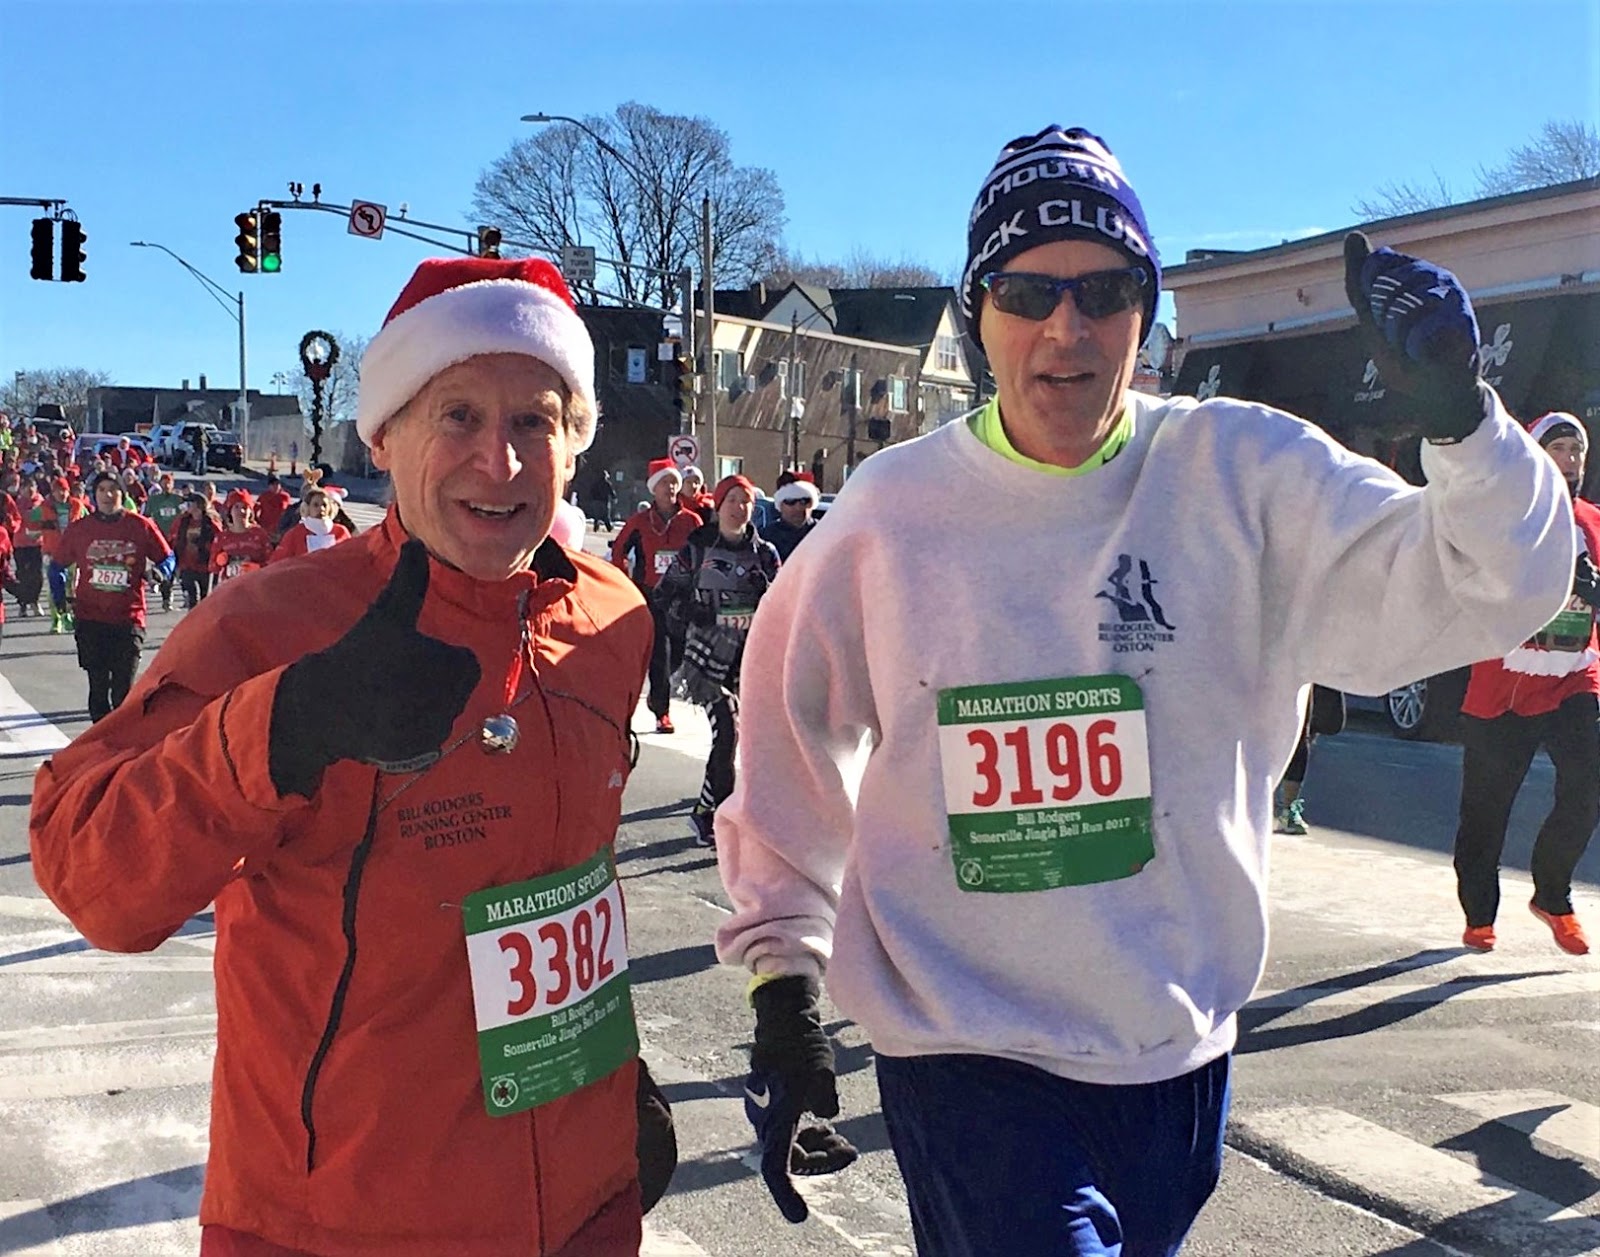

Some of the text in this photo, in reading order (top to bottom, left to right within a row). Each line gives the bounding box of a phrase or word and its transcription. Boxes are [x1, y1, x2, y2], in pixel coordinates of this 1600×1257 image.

[1038, 199, 1149, 257] CLUB
[97, 570, 124, 585] 2672
[1113, 642, 1154, 652] OSTON
[957, 687, 1122, 718] MARATHON SPORTS
[966, 719, 1123, 807] 3196
[969, 817, 1131, 845] Somerville Jingle Bell Run 2017
[1016, 810, 1082, 826] Bill Rodgers
[424, 826, 487, 850] BOSTON
[486, 861, 609, 923] MARATHON SPORTS
[497, 897, 614, 1017] 3382
[503, 1033, 557, 1058] Somerville
